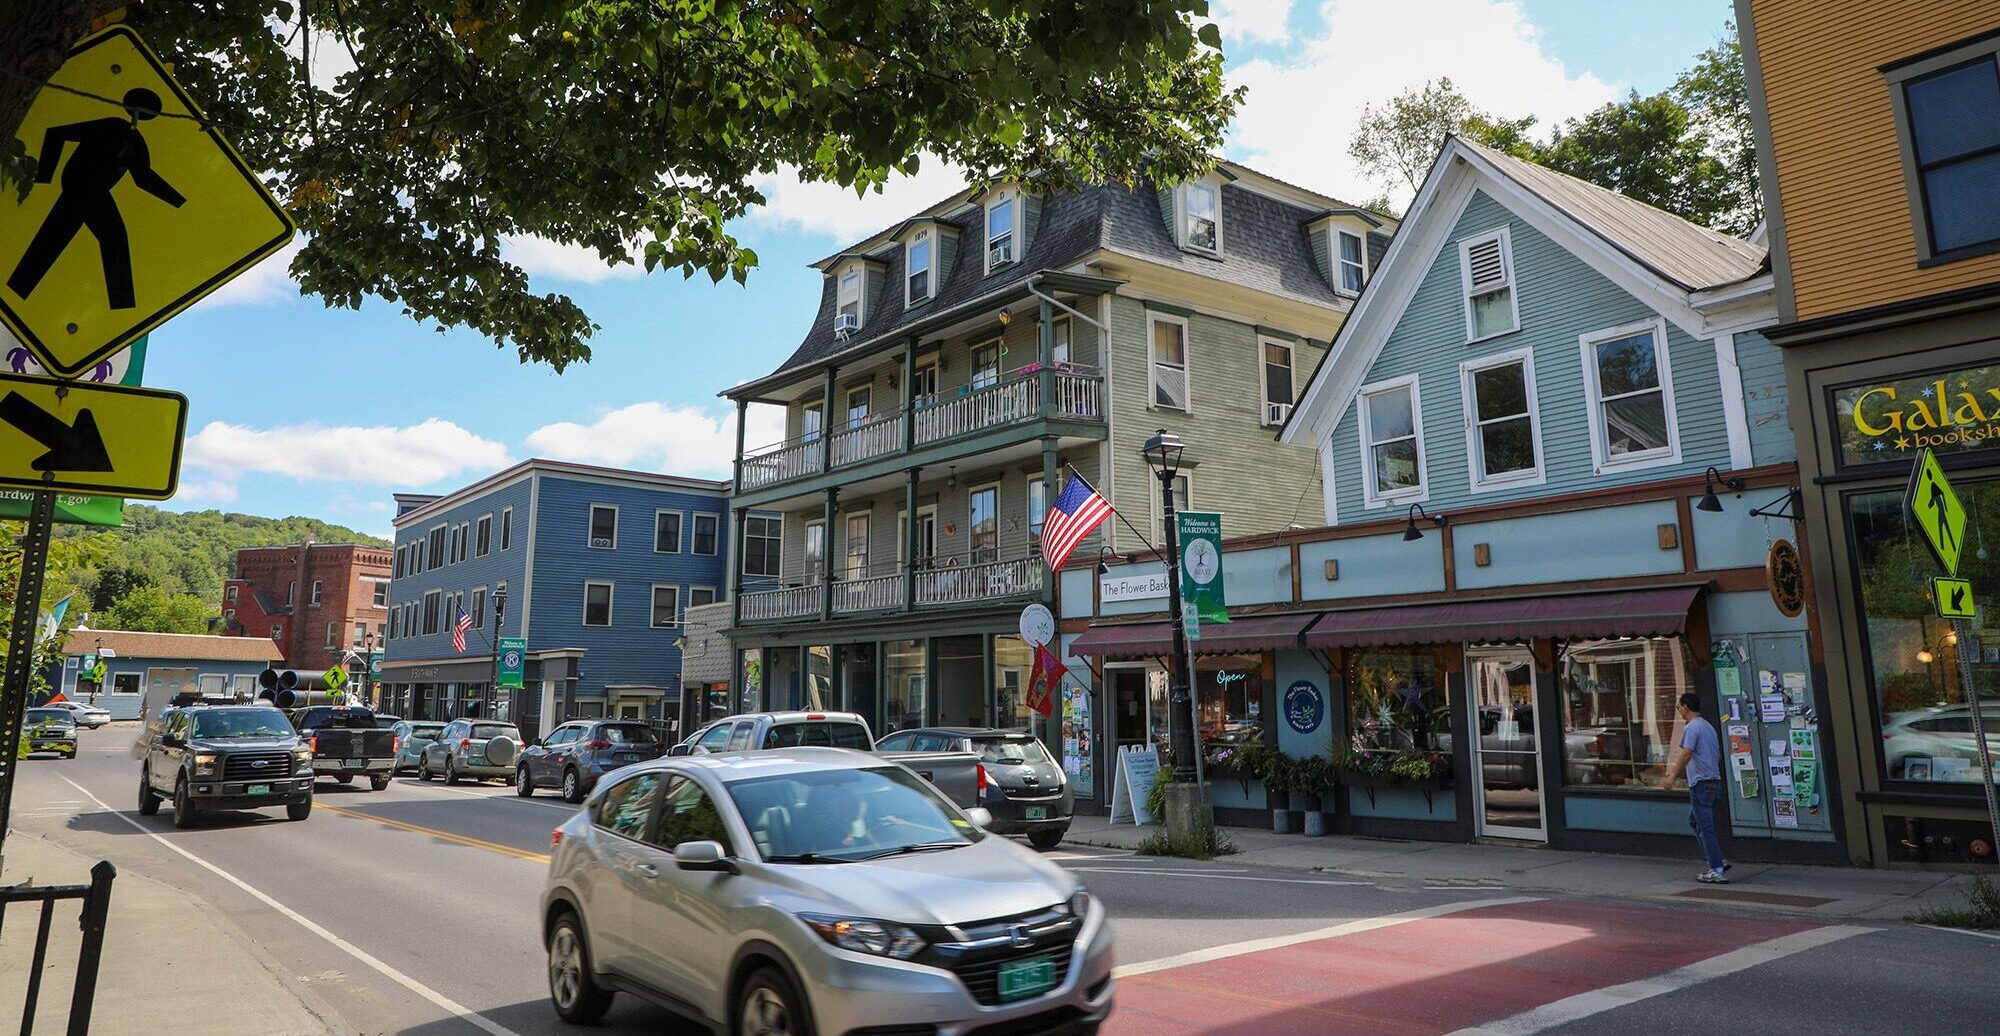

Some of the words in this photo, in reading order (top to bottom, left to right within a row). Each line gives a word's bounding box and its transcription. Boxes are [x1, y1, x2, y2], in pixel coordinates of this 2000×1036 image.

[1913, 422, 2000, 448] booksh
[1184, 518, 1208, 527] Welcome
[1104, 583, 1119, 596] The
[1121, 581, 1148, 594] Flower
[1150, 578, 1169, 592] Bask
[1217, 670, 1245, 690] Open
